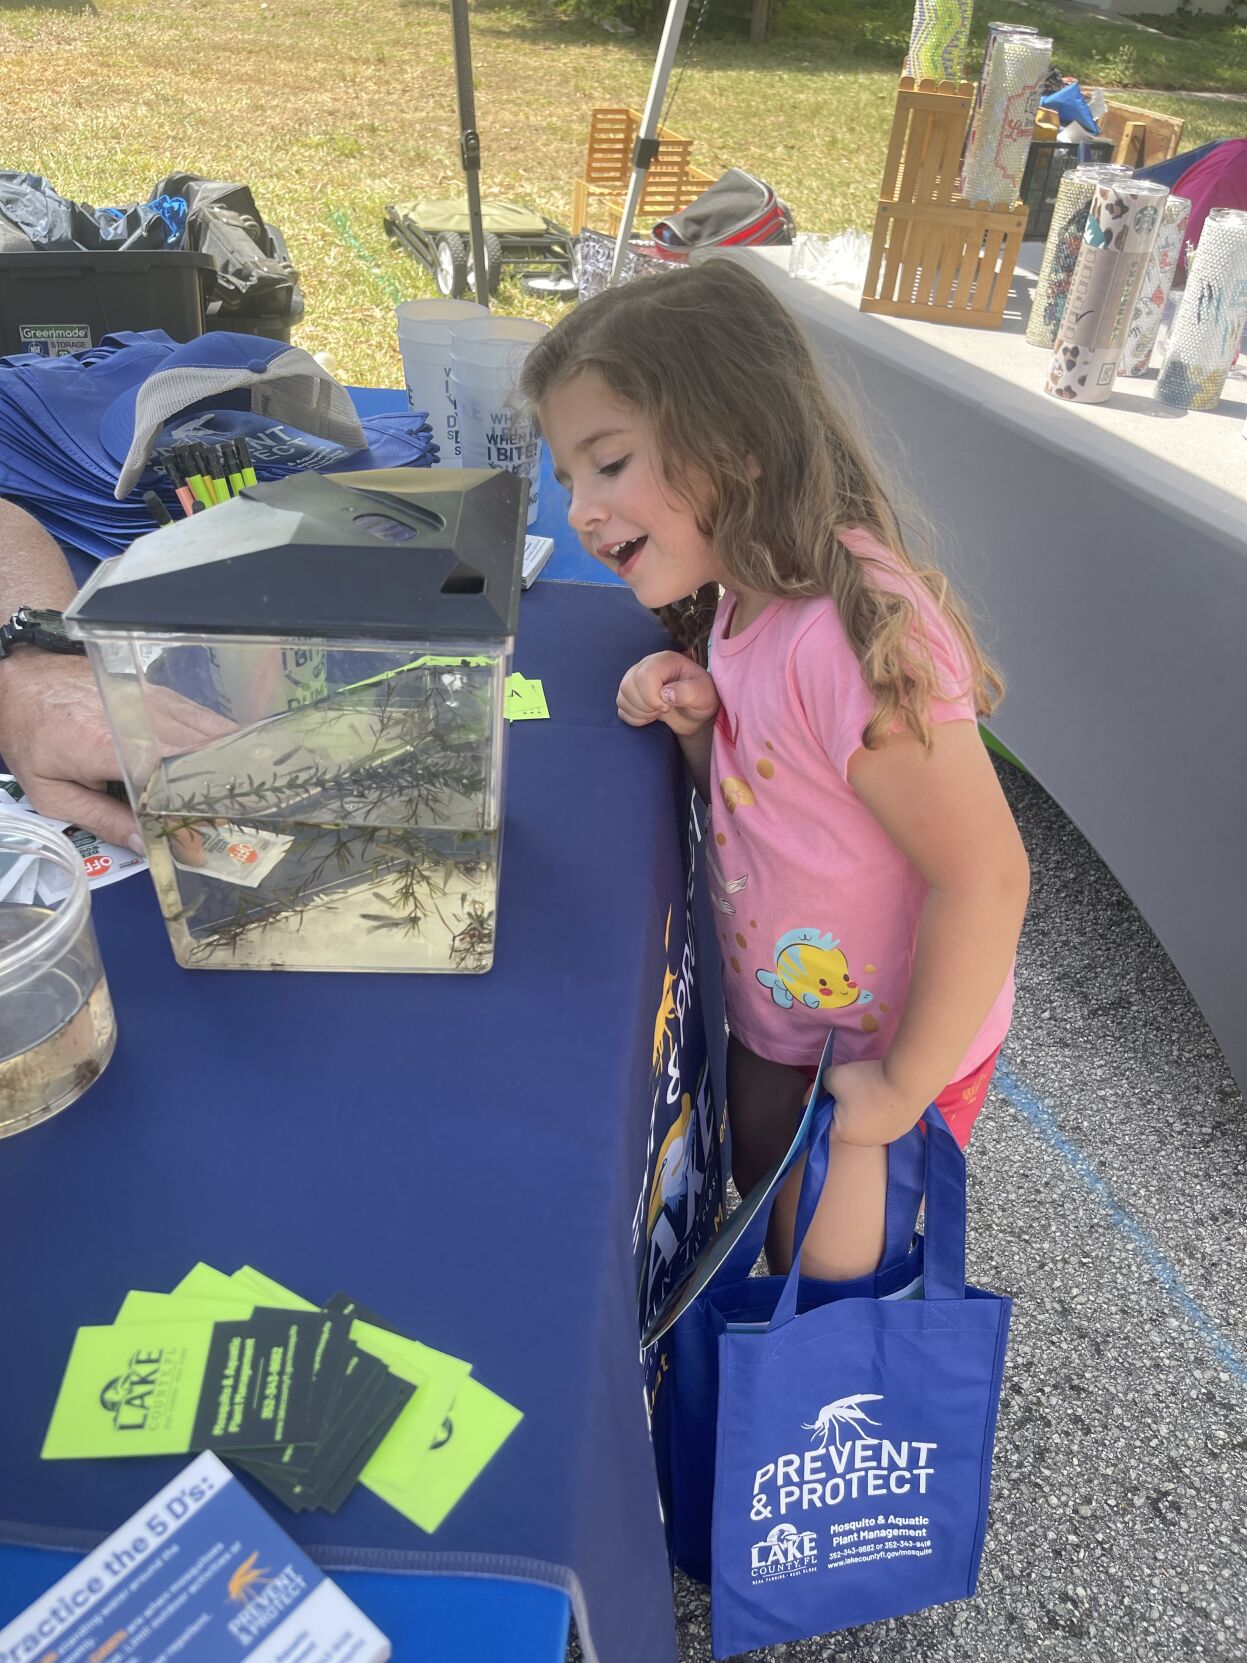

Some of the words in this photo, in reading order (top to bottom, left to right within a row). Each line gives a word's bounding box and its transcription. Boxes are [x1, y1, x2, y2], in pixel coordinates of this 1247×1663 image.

[23, 328, 86, 338] Greenmade
[51, 341, 86, 349] STORAGE
[117, 1348, 164, 1431] LAKE
[753, 1439, 937, 1496] PREVENT
[750, 1494, 773, 1521] &
[780, 1469, 935, 1515] PROTECT
[104, 1536, 149, 1577] the
[147, 1513, 168, 1537] 5
[166, 1476, 216, 1521] D's:
[830, 1517, 876, 1535] Mosquito
[877, 1515, 886, 1525] &
[887, 1515, 930, 1527] Aquatic
[832, 1532, 859, 1547] Plant
[860, 1528, 928, 1540] Management
[751, 1532, 818, 1568] LAKE
[804, 1555, 818, 1565] FL
[226, 1563, 300, 1636] PREVENT
